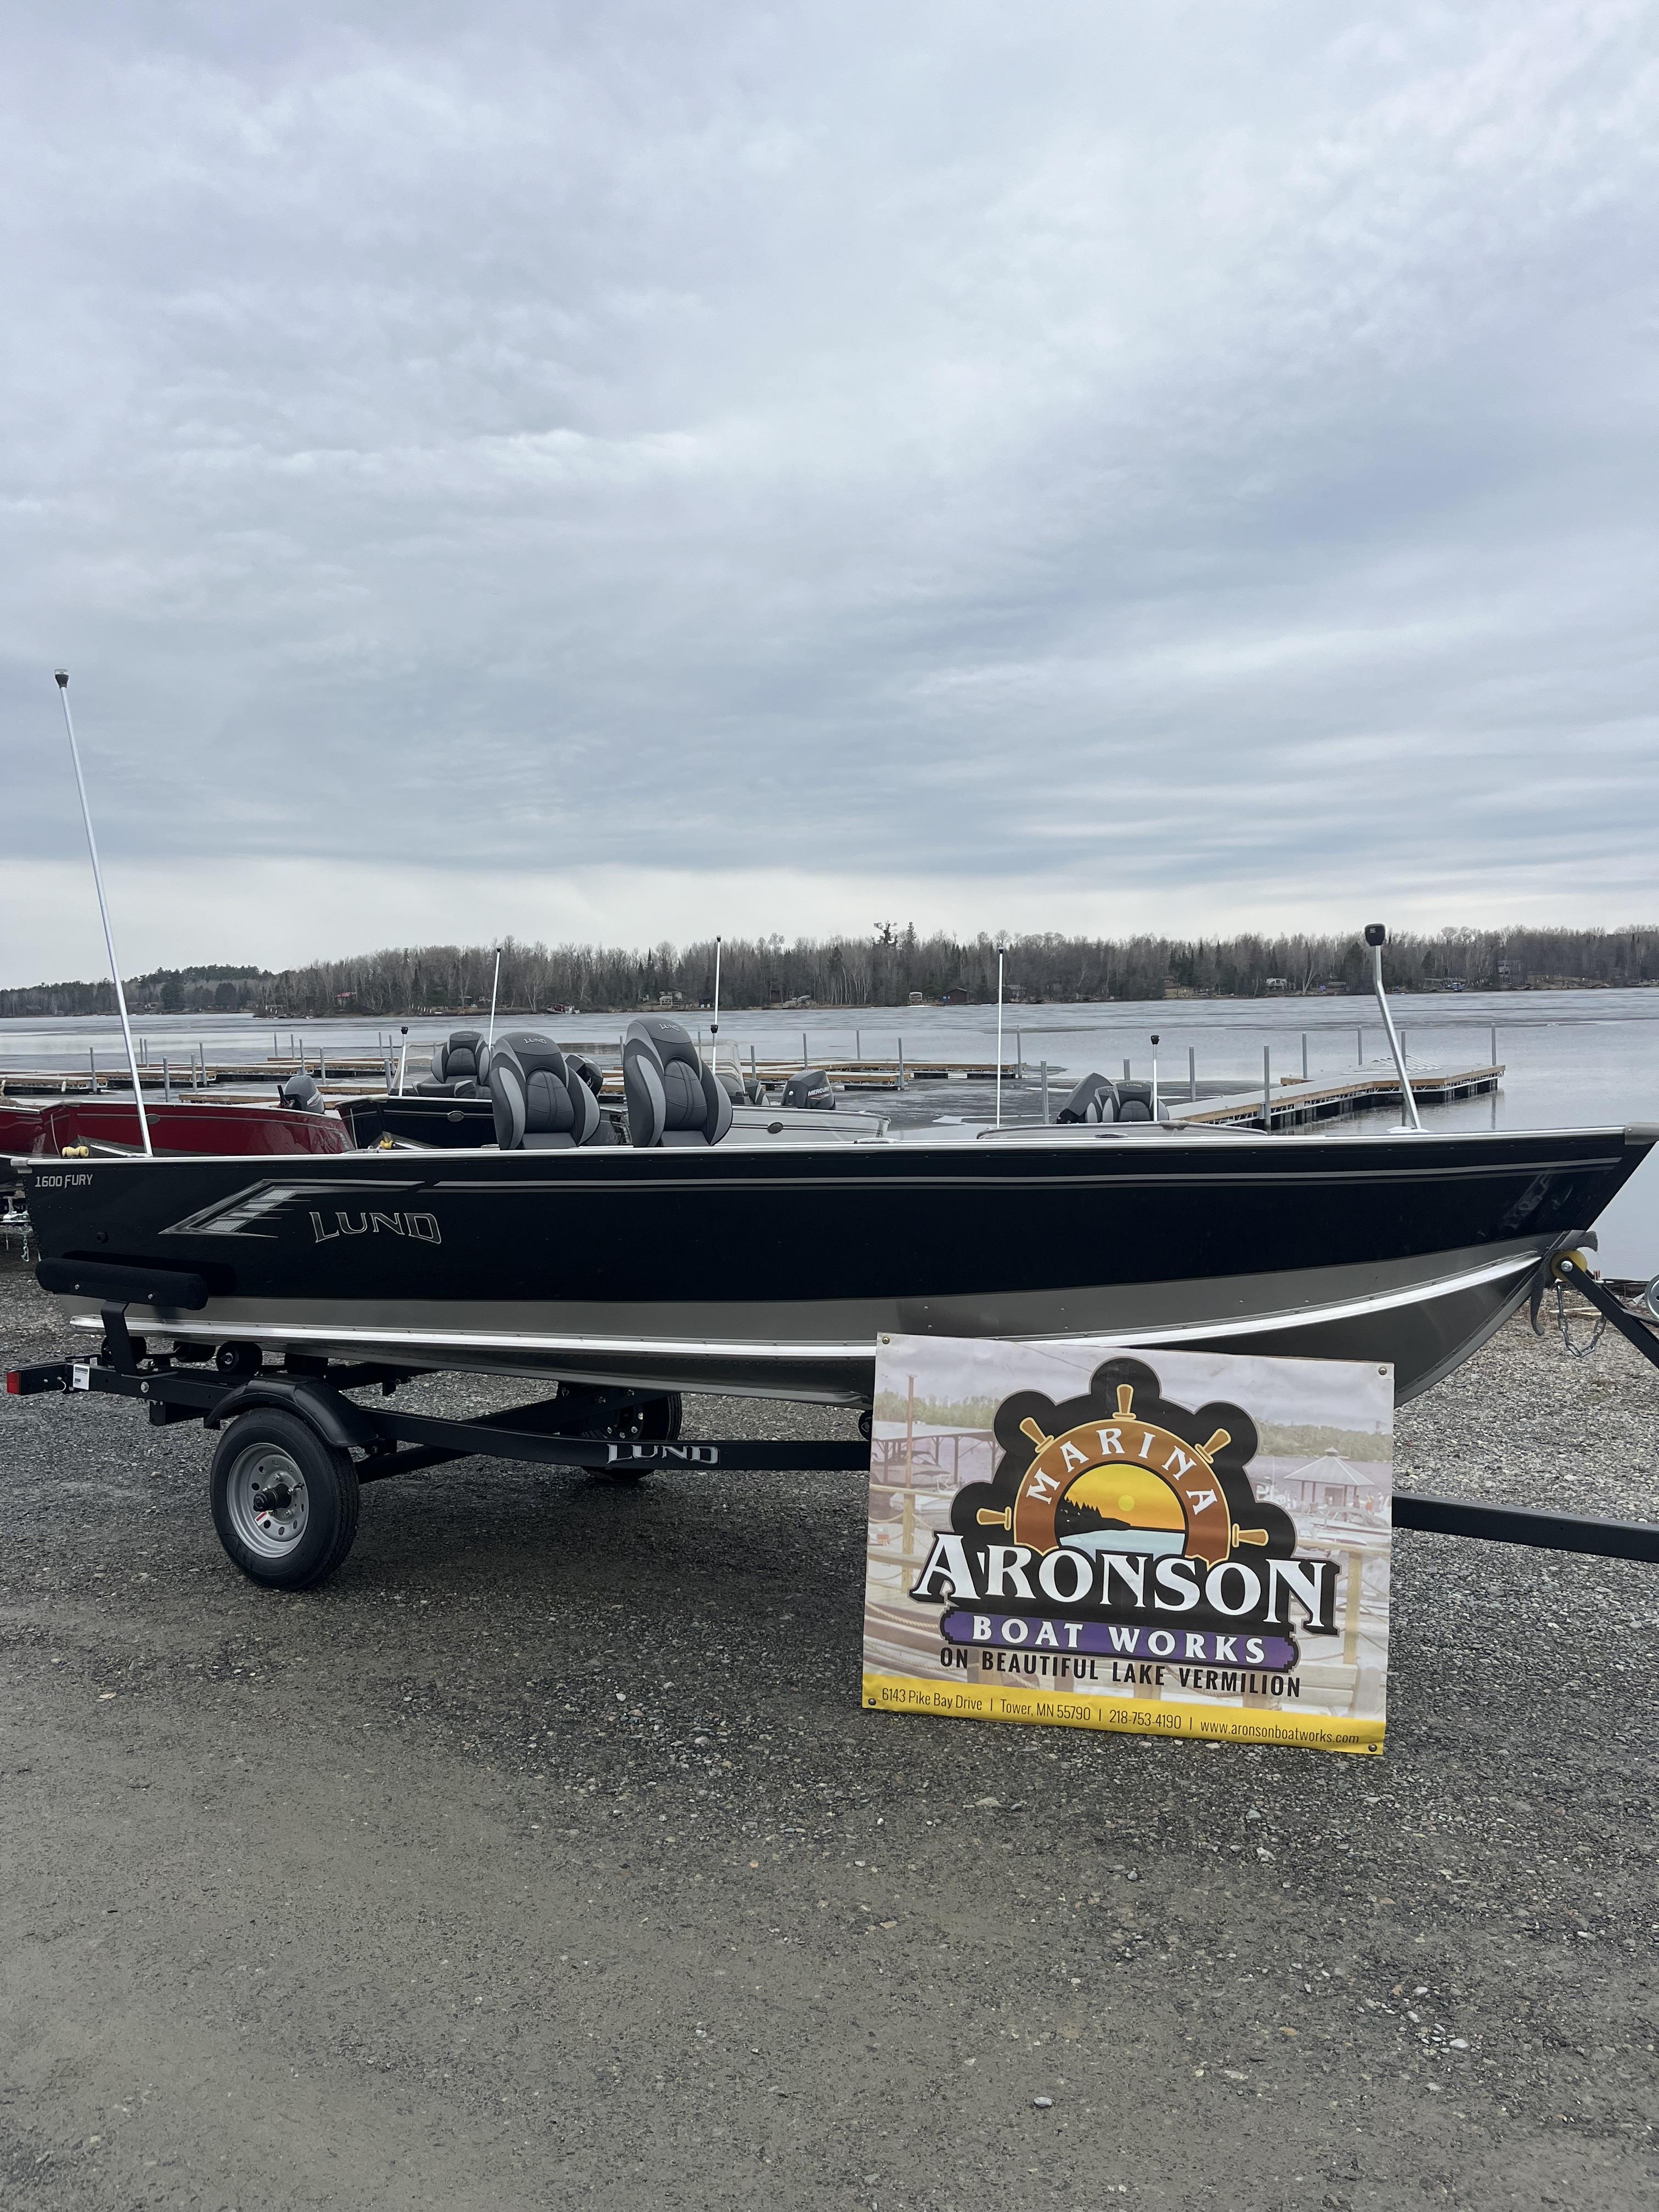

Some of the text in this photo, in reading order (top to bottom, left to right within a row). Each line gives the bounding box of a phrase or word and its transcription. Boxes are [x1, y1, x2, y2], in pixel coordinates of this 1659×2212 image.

[35, 1173, 93, 1189] 1600 FURY
[309, 1212, 442, 1244] LUND
[606, 1443, 720, 1465] LUND
[1026, 1427, 1218, 1515] MARINA
[912, 1533, 1327, 1627] ARONSON
[972, 1615, 1265, 1664] BOAT WORKS
[940, 1647, 1301, 1698] ON BEAUTIFUL LAKE VERMILION
[882, 1687, 1359, 1744] 6143 Pike Bay Drive Tower, MN 55790 218-753-4190 www.aronsonboatworks.com
